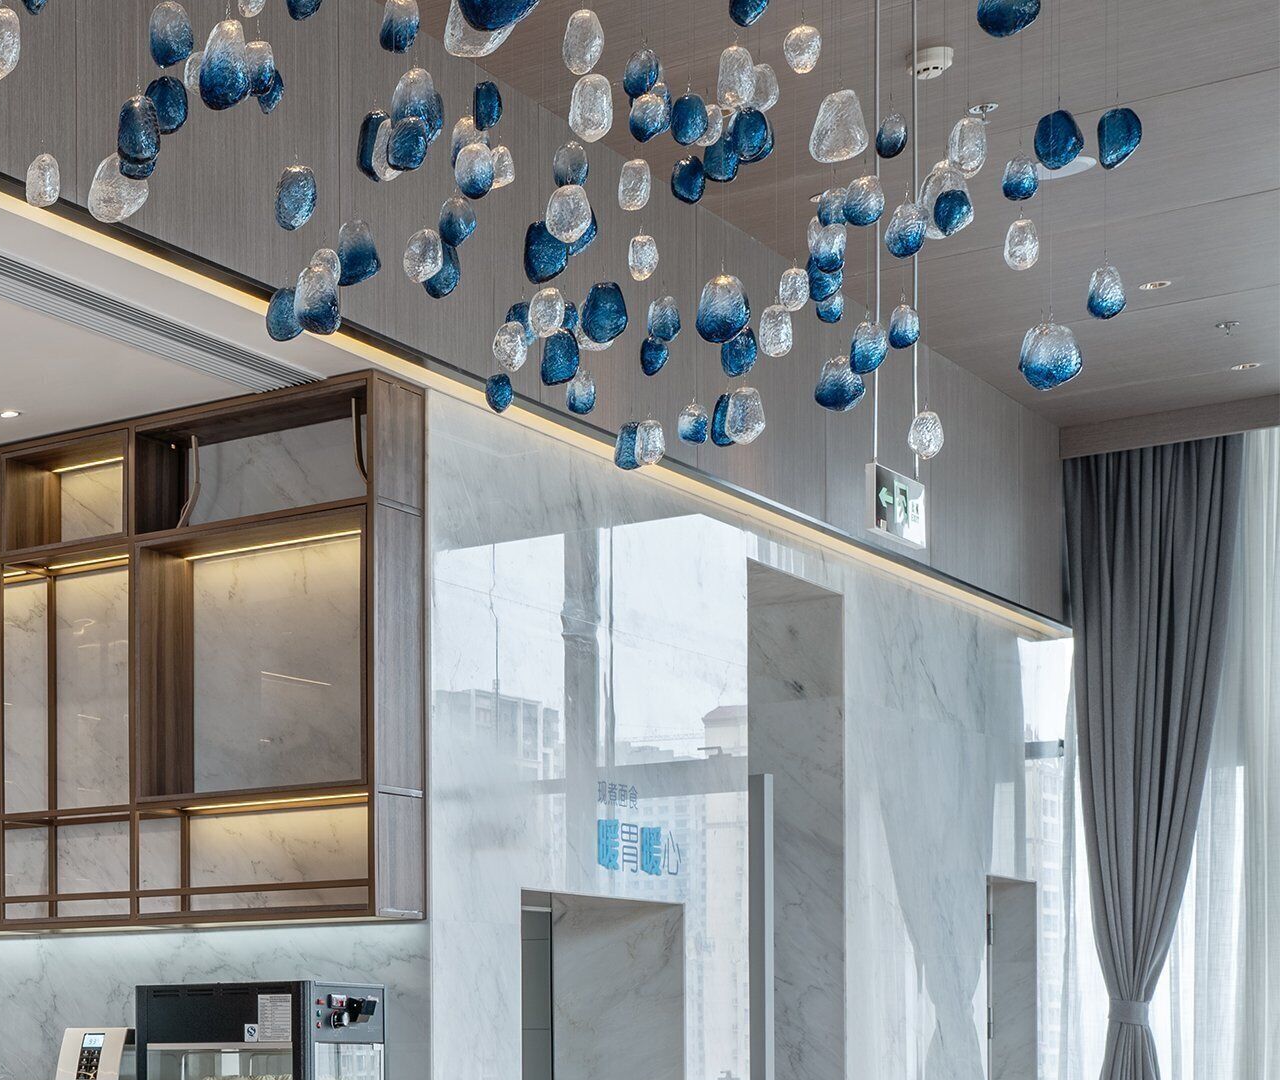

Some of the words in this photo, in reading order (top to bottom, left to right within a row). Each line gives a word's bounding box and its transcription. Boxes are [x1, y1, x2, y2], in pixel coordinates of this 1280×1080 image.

[597, 780, 638, 810] 现煮面食
[597, 818, 682, 877] 暖胃暖心
